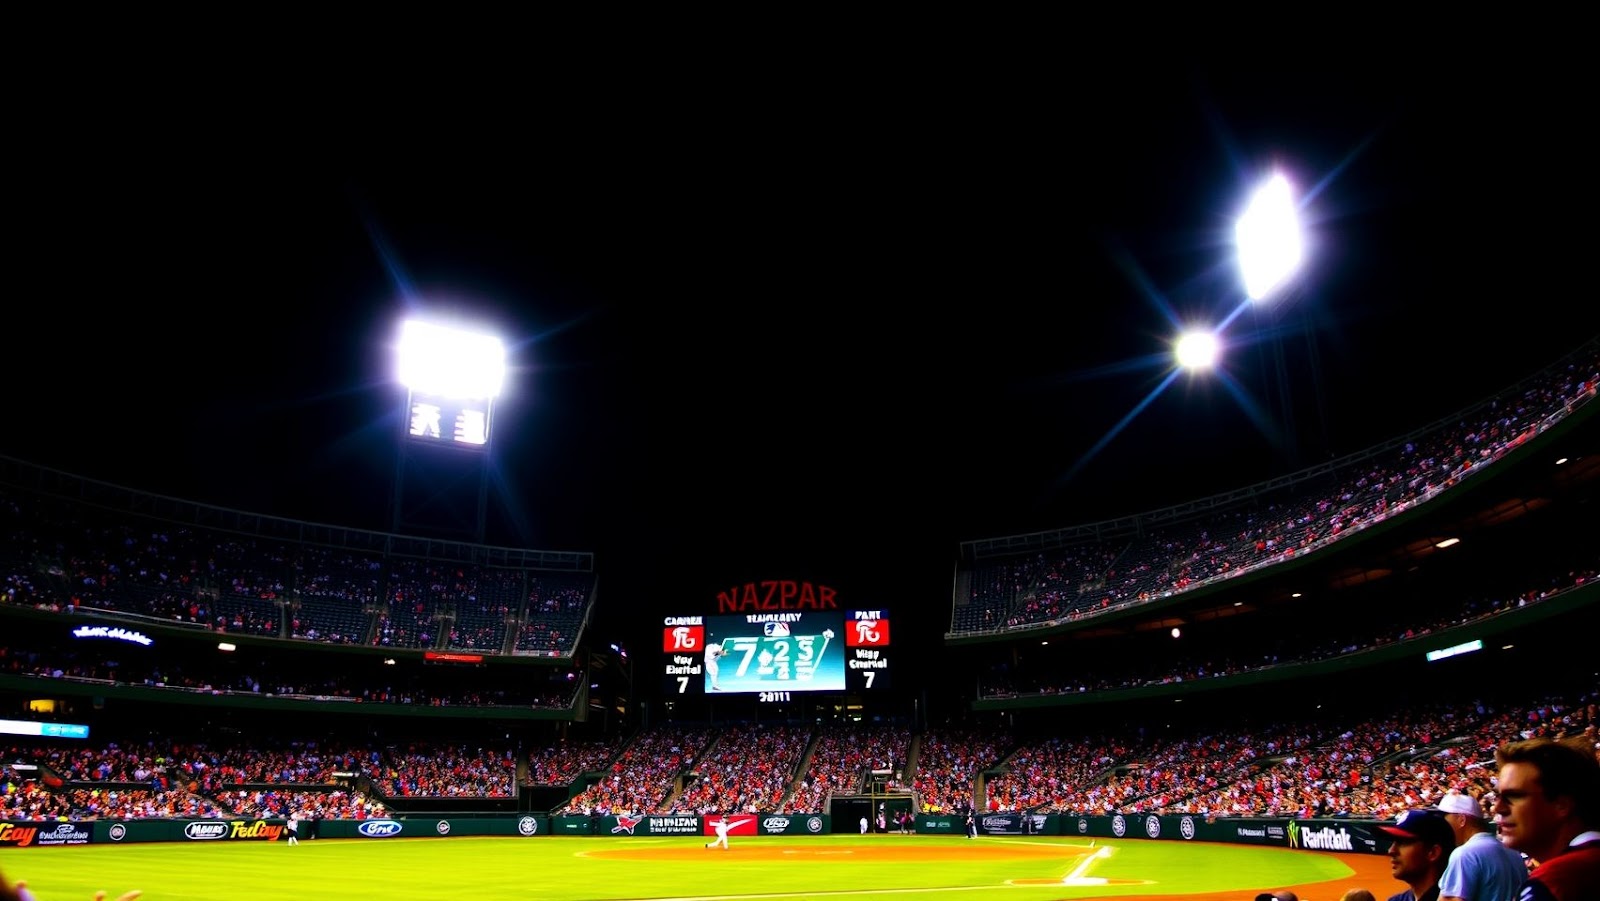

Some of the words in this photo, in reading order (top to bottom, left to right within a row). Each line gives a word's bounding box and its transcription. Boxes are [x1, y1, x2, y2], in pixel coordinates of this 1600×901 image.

[716, 580, 837, 613] NAZPAR
[677, 676, 689, 694] 7
[863, 671, 876, 689] 7
